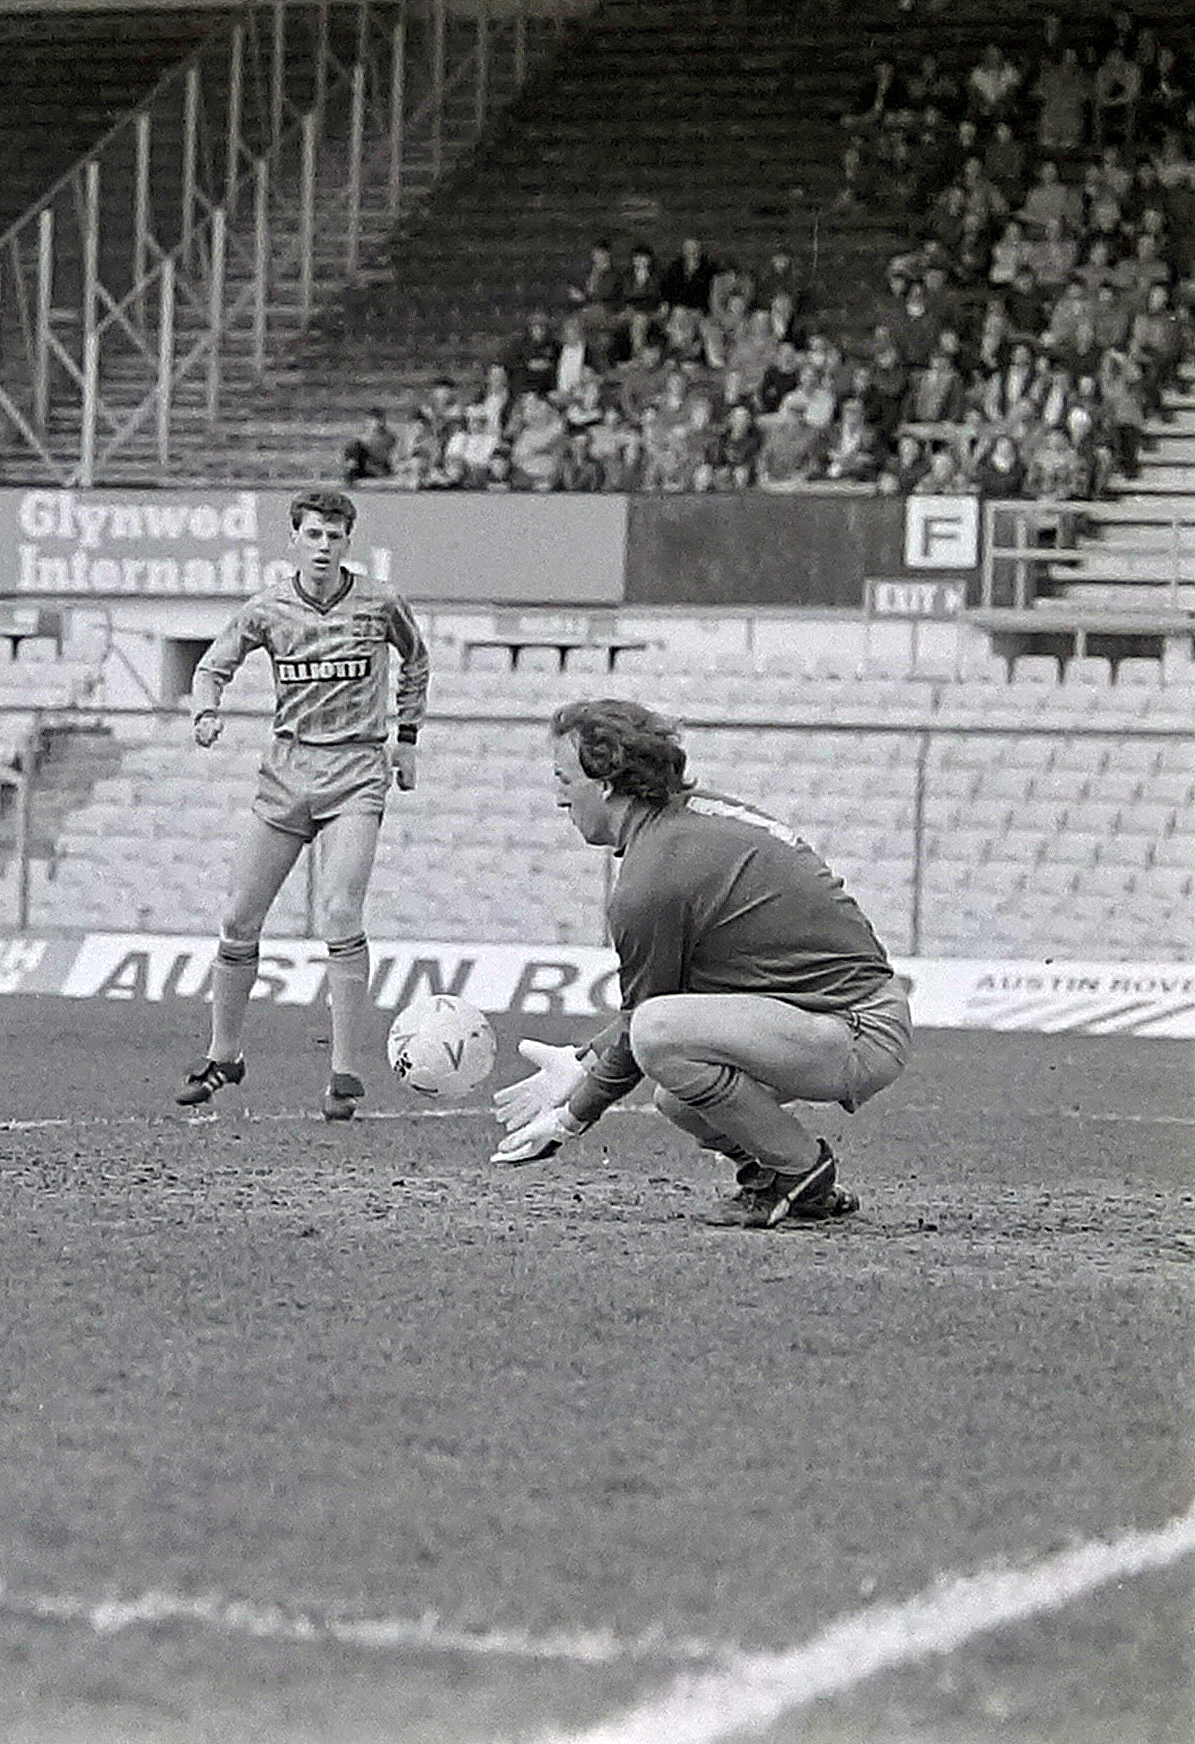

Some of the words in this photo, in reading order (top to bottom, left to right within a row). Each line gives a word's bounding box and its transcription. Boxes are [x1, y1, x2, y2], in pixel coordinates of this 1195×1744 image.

[922, 516, 962, 557] F
[17, 544, 392, 590] Internatiol
[976, 974, 1100, 992] AUSTIN
